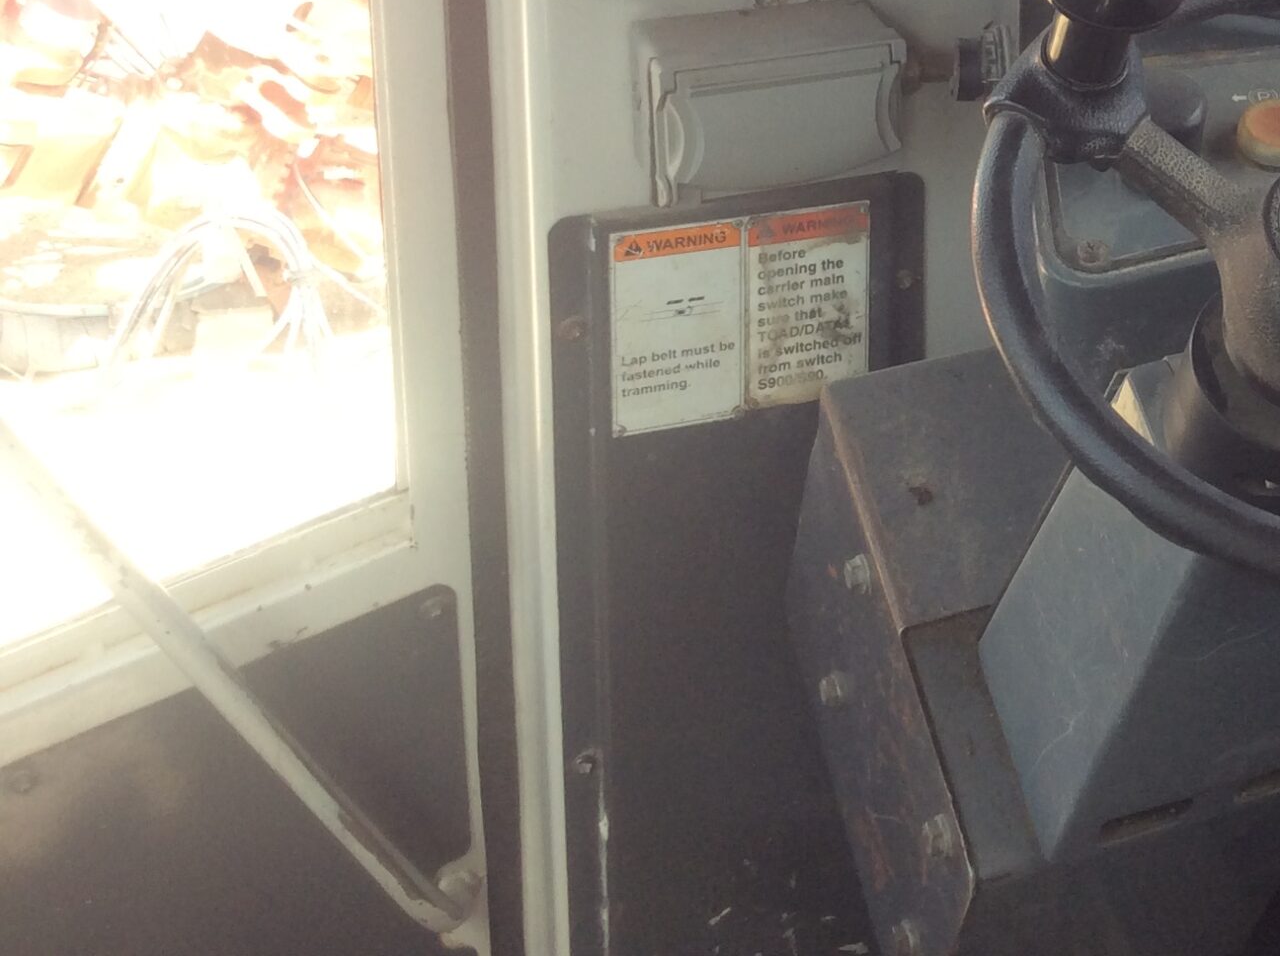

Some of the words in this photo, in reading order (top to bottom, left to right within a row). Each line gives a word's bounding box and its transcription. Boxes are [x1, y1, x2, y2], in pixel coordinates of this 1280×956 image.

[783, 216, 852, 234] WARN
[646, 231, 727, 252] WARNING
[759, 250, 806, 263] Before
[758, 263, 817, 280] opening
[821, 259, 844, 271] the
[758, 280, 805, 295] carrier
[810, 274, 844, 288] main
[758, 295, 804, 311] switch
[810, 290, 847, 303] make
[795, 308, 823, 321] that
[622, 355, 647, 366] Lap
[651, 349, 677, 363] belt
[681, 343, 716, 357] must
[719, 341, 735, 352] be
[758, 349, 770, 359] is
[775, 339, 838, 357] switched
[843, 332, 862, 345] off
[622, 364, 680, 382] fastened
[685, 359, 720, 370] while
[759, 362, 790, 374] from
[797, 352, 842, 368] switch
[622, 380, 691, 397] tramming.
